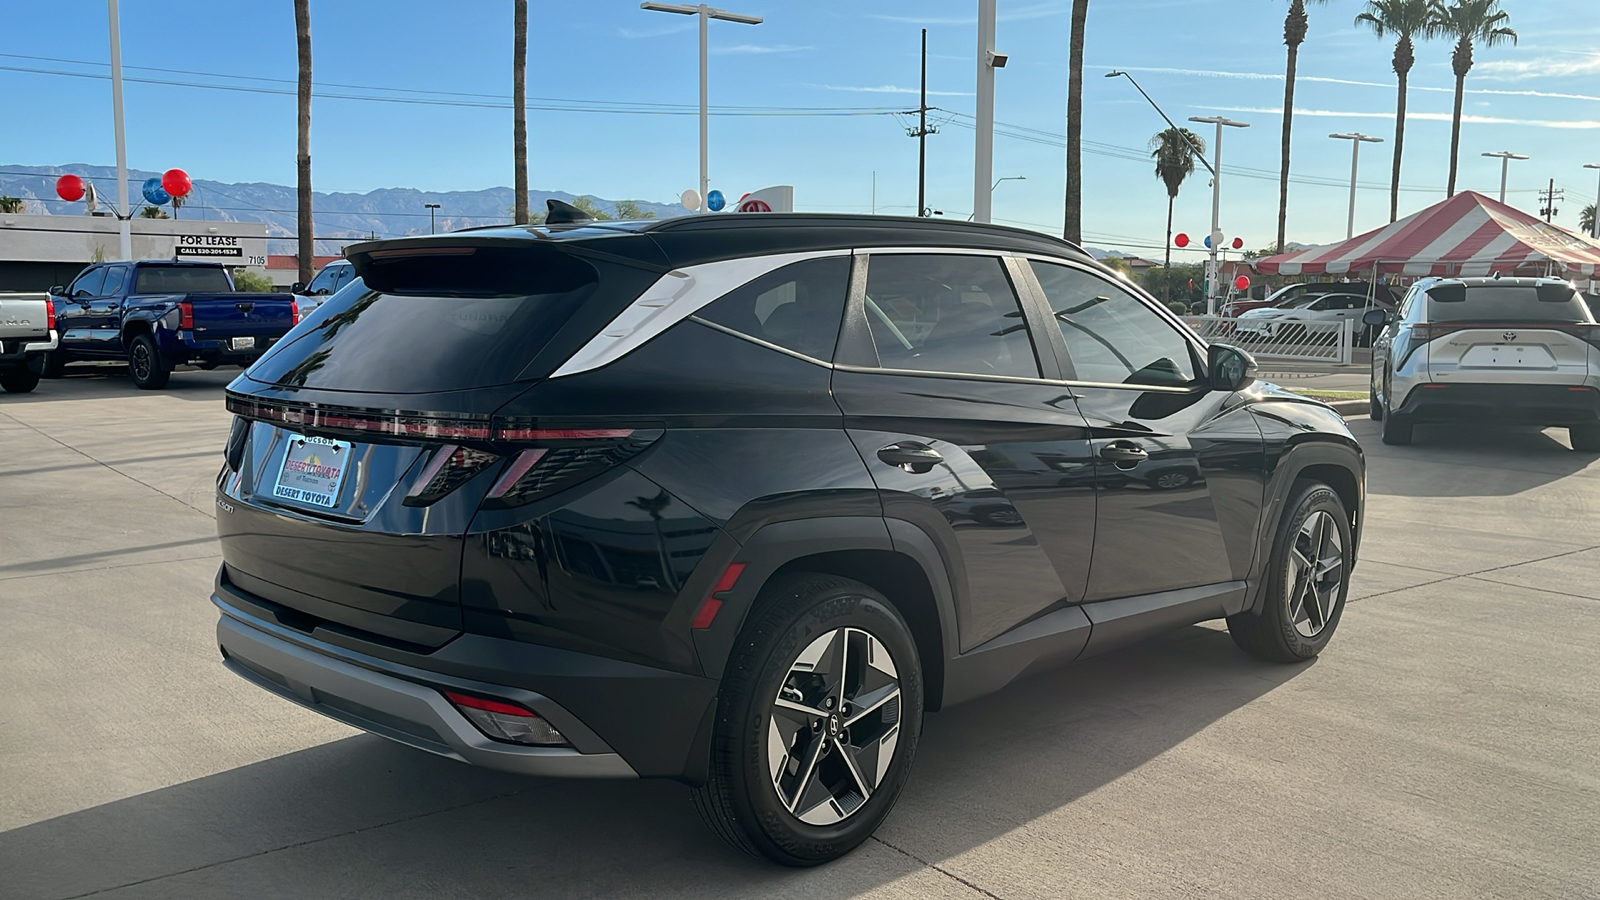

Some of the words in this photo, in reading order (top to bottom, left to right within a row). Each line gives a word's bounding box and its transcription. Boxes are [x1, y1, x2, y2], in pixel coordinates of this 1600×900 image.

[180, 235, 202, 245] FOR
[206, 236, 237, 246] LEASE
[249, 255, 265, 265] 7105
[304, 437, 334, 446] TUCSON
[285, 459, 311, 473] DESERT
[312, 464, 341, 479] TOYOTA
[302, 475, 319, 485] Tucson
[275, 486, 301, 498] DESERT
[301, 491, 331, 505] TOYOTA
